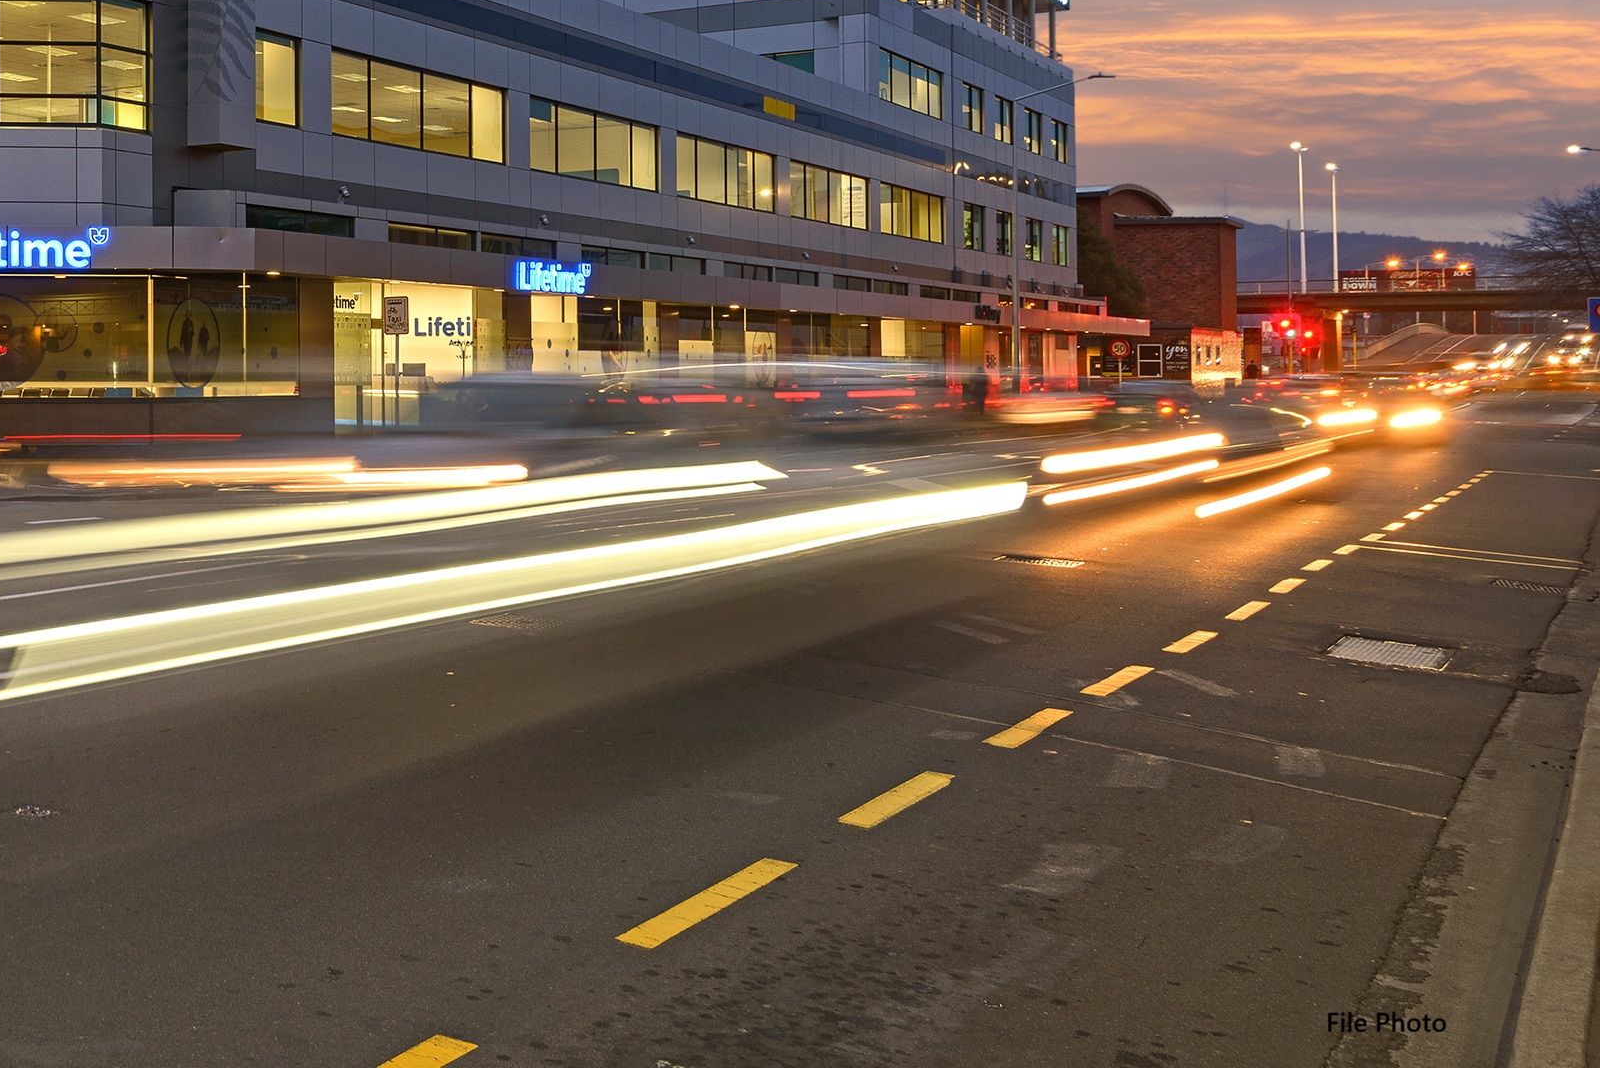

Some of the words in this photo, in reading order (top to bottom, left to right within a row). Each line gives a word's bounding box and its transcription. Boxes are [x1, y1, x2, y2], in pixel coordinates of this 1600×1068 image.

[518, 261, 586, 294] Lifetime
[332, 295, 355, 309] time
[388, 315, 401, 324] Taxi
[414, 316, 471, 337] Lifeti
[1113, 343, 1125, 353] 50
